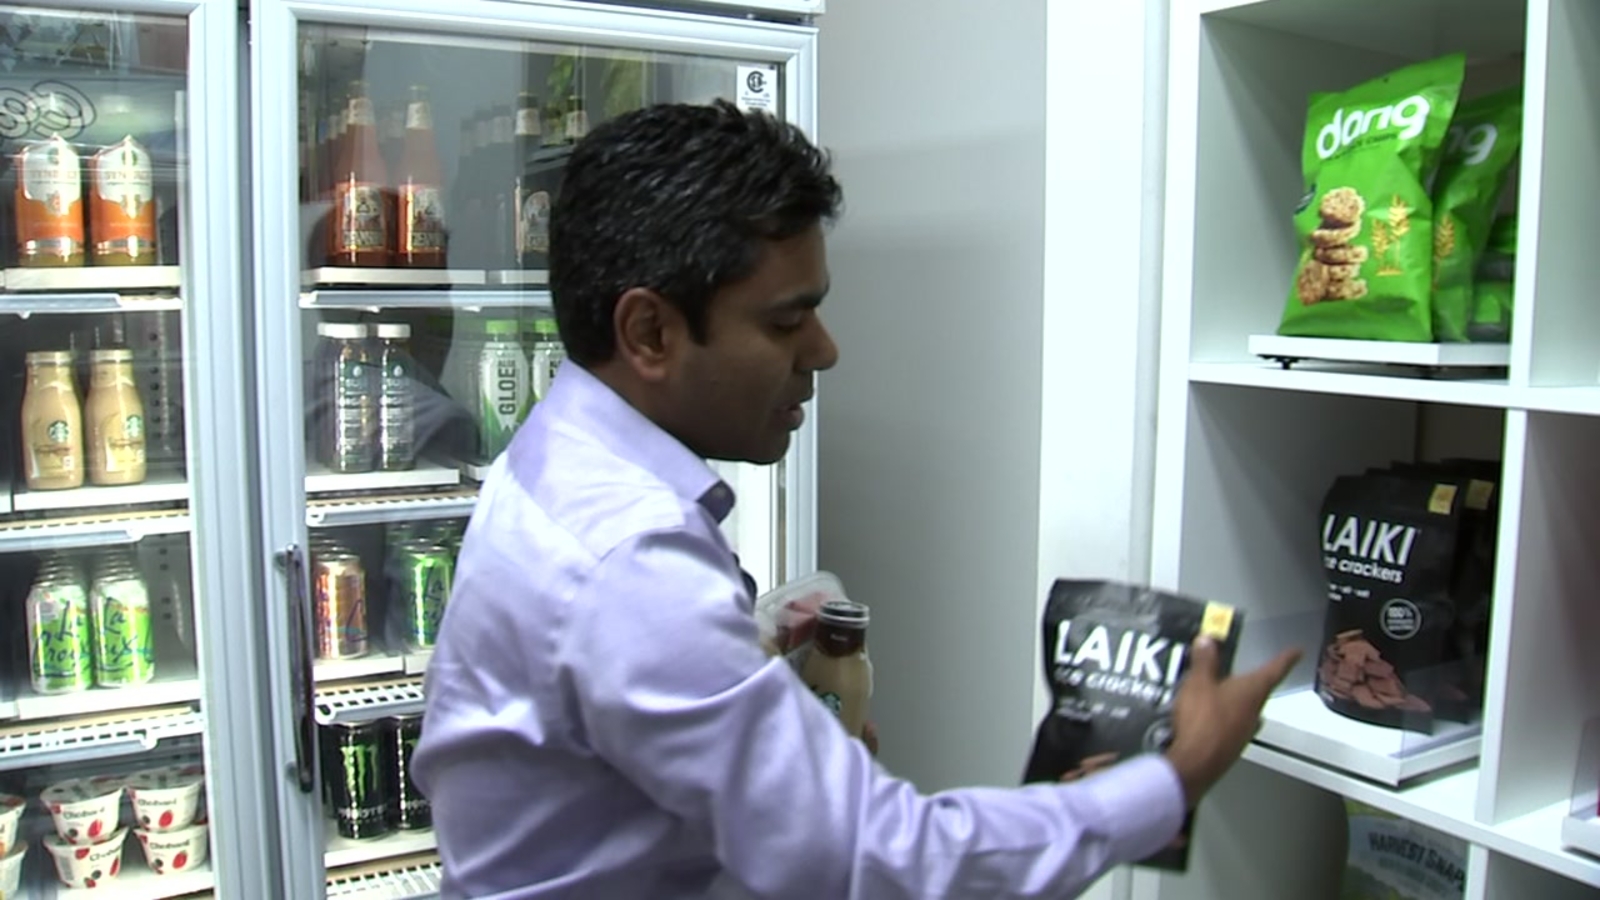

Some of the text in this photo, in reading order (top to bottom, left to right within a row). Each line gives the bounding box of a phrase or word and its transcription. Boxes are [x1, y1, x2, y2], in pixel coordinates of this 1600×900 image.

[1316, 95, 1430, 159] dang
[1322, 514, 1416, 566] LAIKI
[1338, 559, 1403, 584] crackers
[1054, 619, 1185, 686] LAIKI
